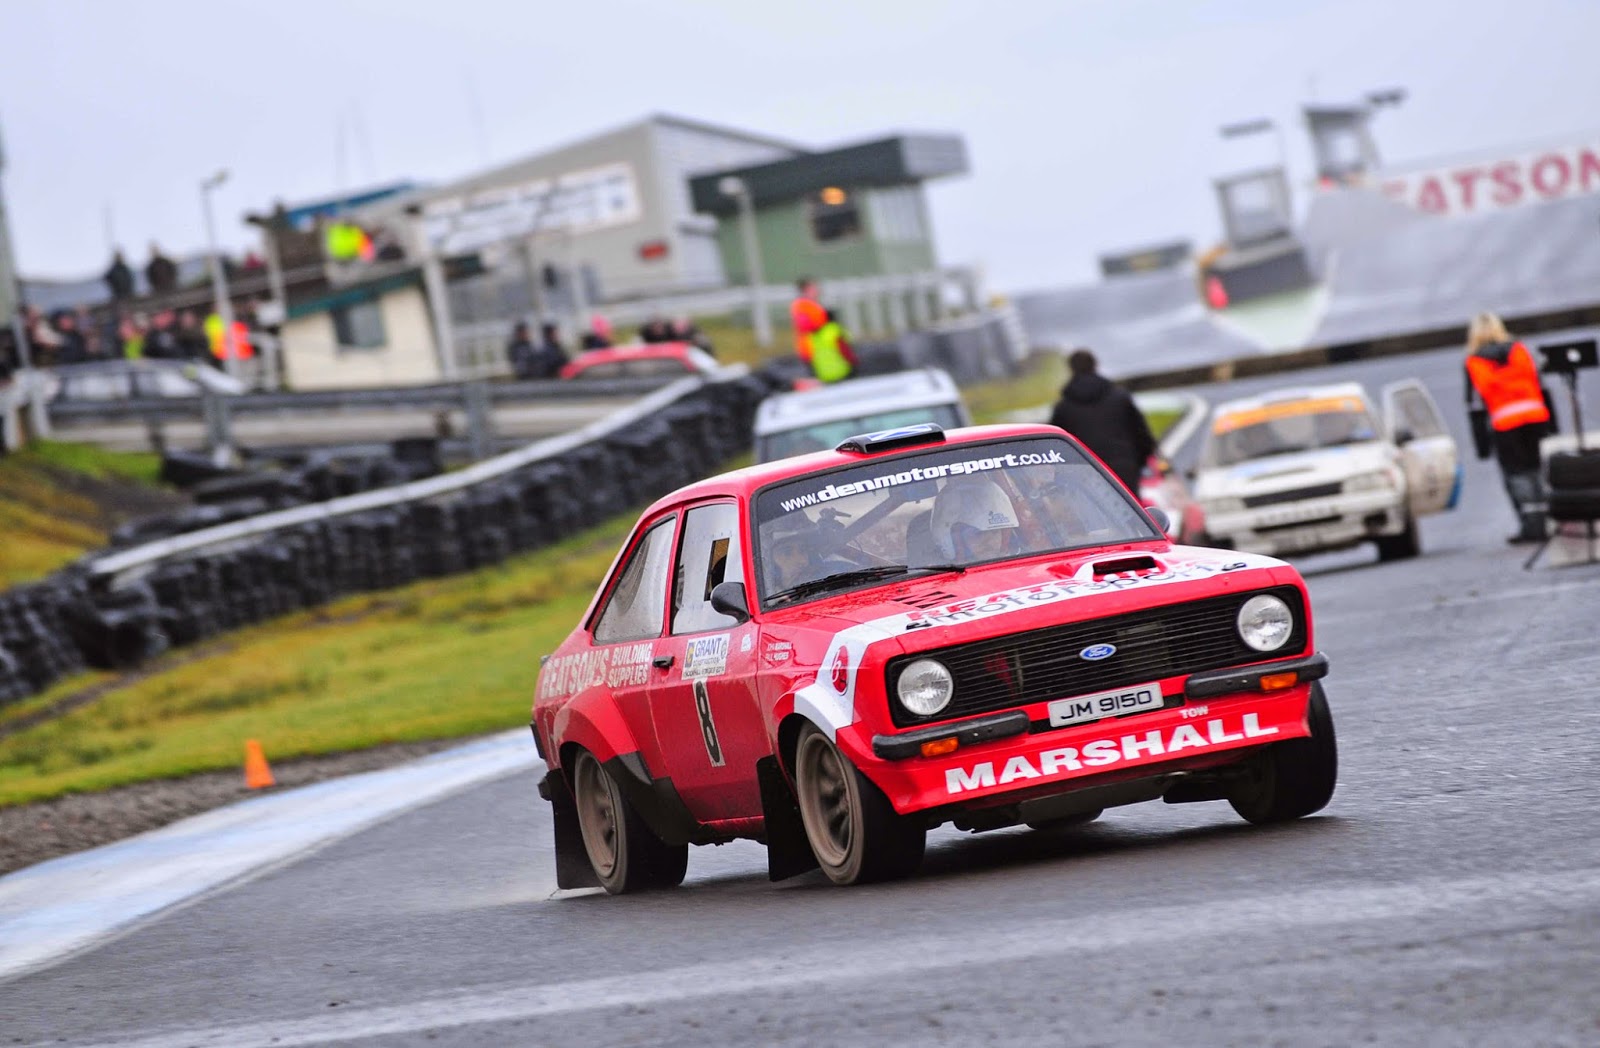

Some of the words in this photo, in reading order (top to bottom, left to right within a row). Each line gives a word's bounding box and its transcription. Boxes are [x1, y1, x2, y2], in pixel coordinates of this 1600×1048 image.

[781, 450, 1065, 512] www.denmotorsport.co.uk
[611, 642, 653, 666] BUILDING
[695, 638, 722, 657] GRANT
[607, 664, 648, 687] SUPPLIES
[1060, 701, 1093, 720] JM
[1099, 690, 1153, 712] 9150
[1179, 705, 1209, 719] TOW
[695, 680, 720, 763] 8
[945, 712, 1279, 794] MARSHALL
